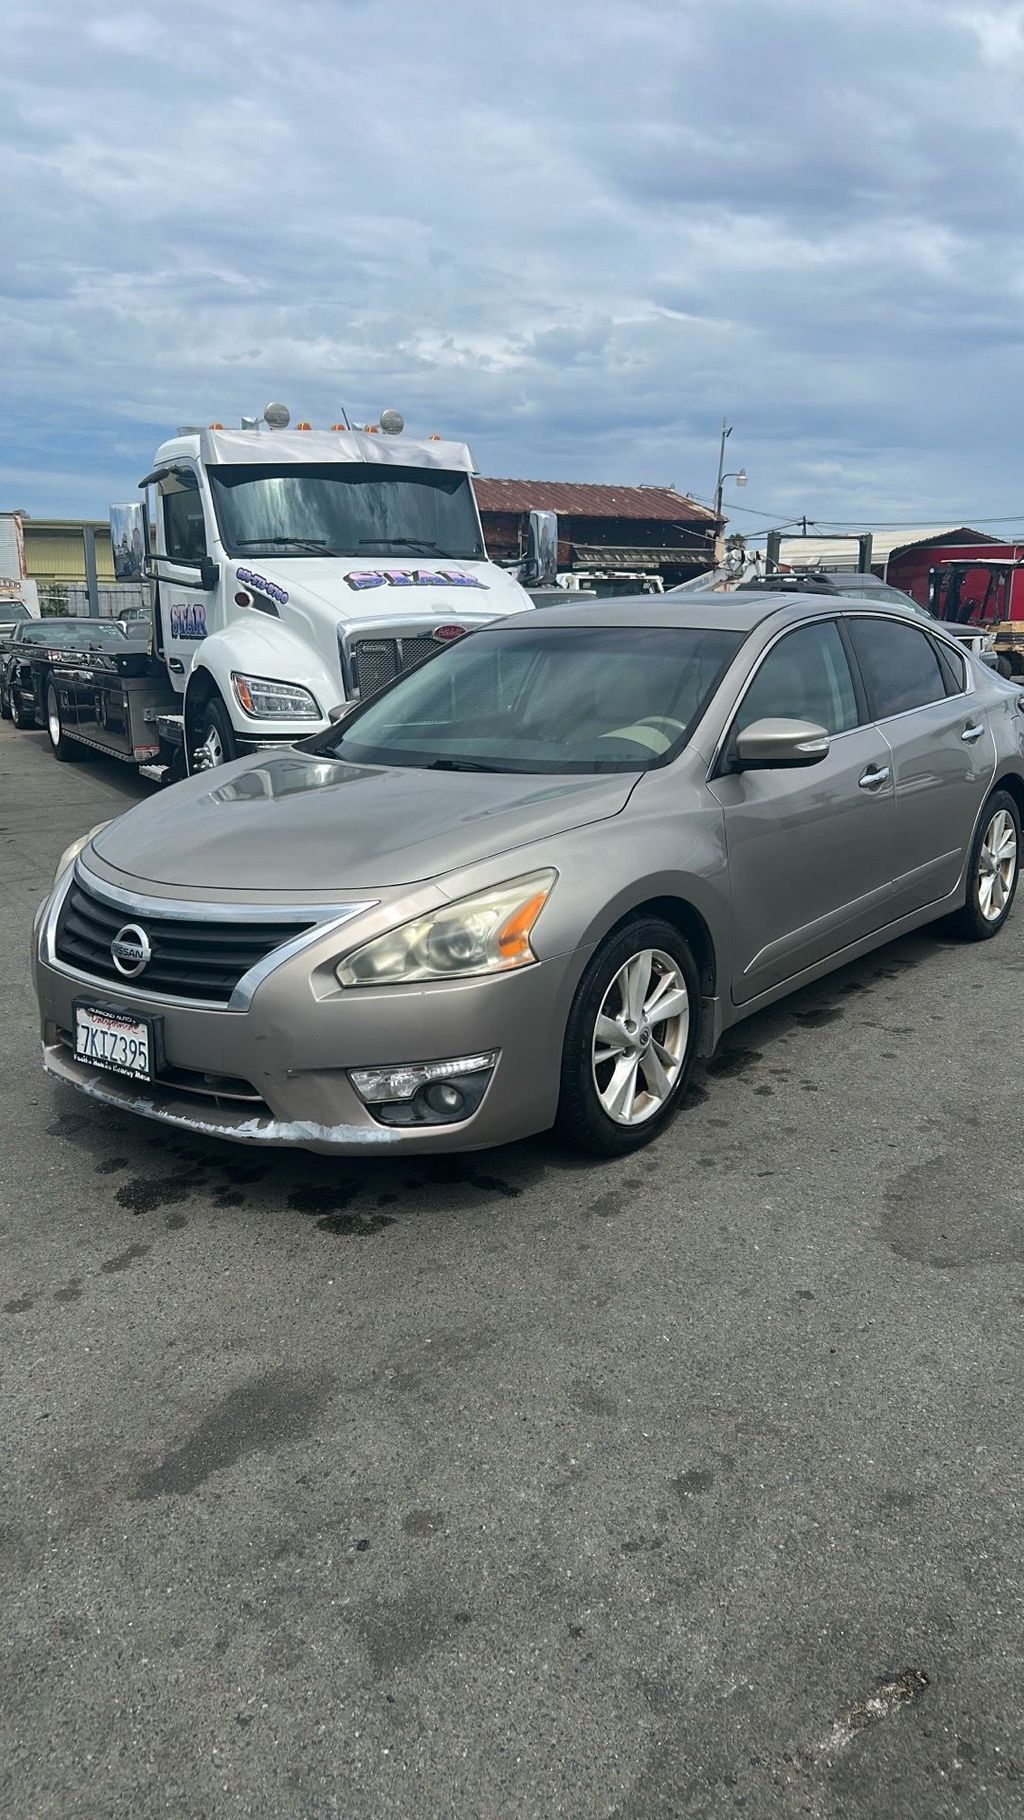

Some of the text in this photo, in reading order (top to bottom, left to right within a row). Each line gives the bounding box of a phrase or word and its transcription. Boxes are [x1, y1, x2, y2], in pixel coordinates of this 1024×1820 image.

[343, 569, 491, 591] STAR
[171, 604, 208, 640] STAR
[112, 942, 144, 959] NISSAN
[80, 1024, 147, 1070] 7KIZ395
